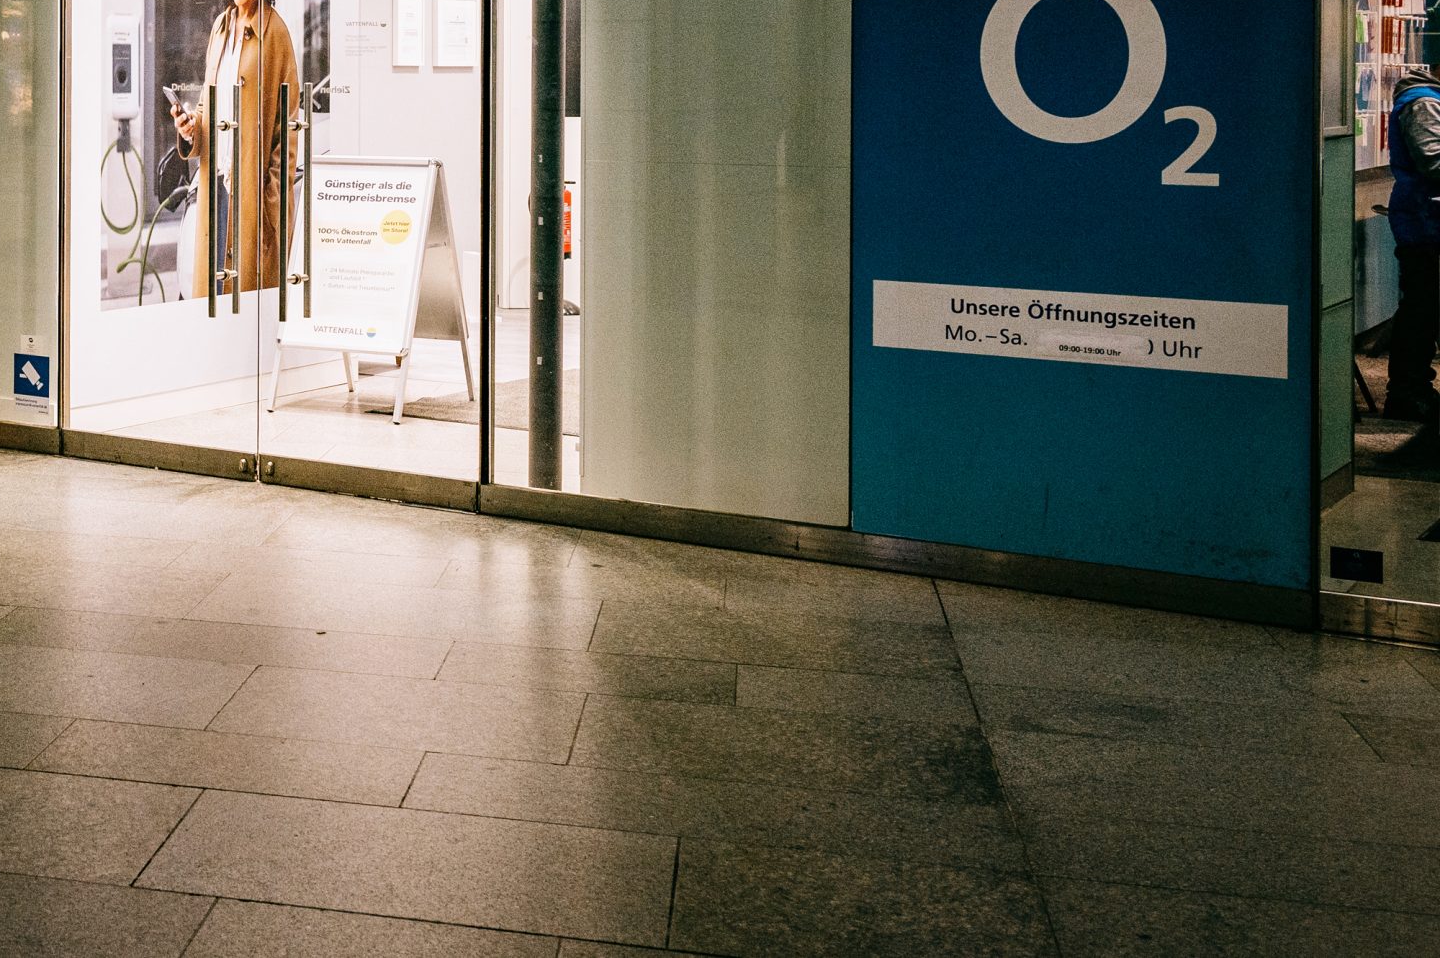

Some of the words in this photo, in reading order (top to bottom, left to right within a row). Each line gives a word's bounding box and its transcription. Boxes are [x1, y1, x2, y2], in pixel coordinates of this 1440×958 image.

[324, 179, 376, 191] Günstiger
[378, 181, 393, 190] als
[395, 181, 412, 191] die
[317, 192, 417, 204] Strompreisbremse
[318, 227, 340, 235] 100%
[341, 227, 378, 237] Ökostrom
[336, 237, 372, 245] Vattenfall
[950, 298, 1021, 318] Unsere
[1027, 299, 1196, 331] Öffnungszeiten
[313, 324, 365, 336] VATTENFALL
[1058, 343, 1103, 356] 09:00-19:00
[1103, 346, 1122, 357] Uhr
[1162, 339, 1203, 359] Uhr
